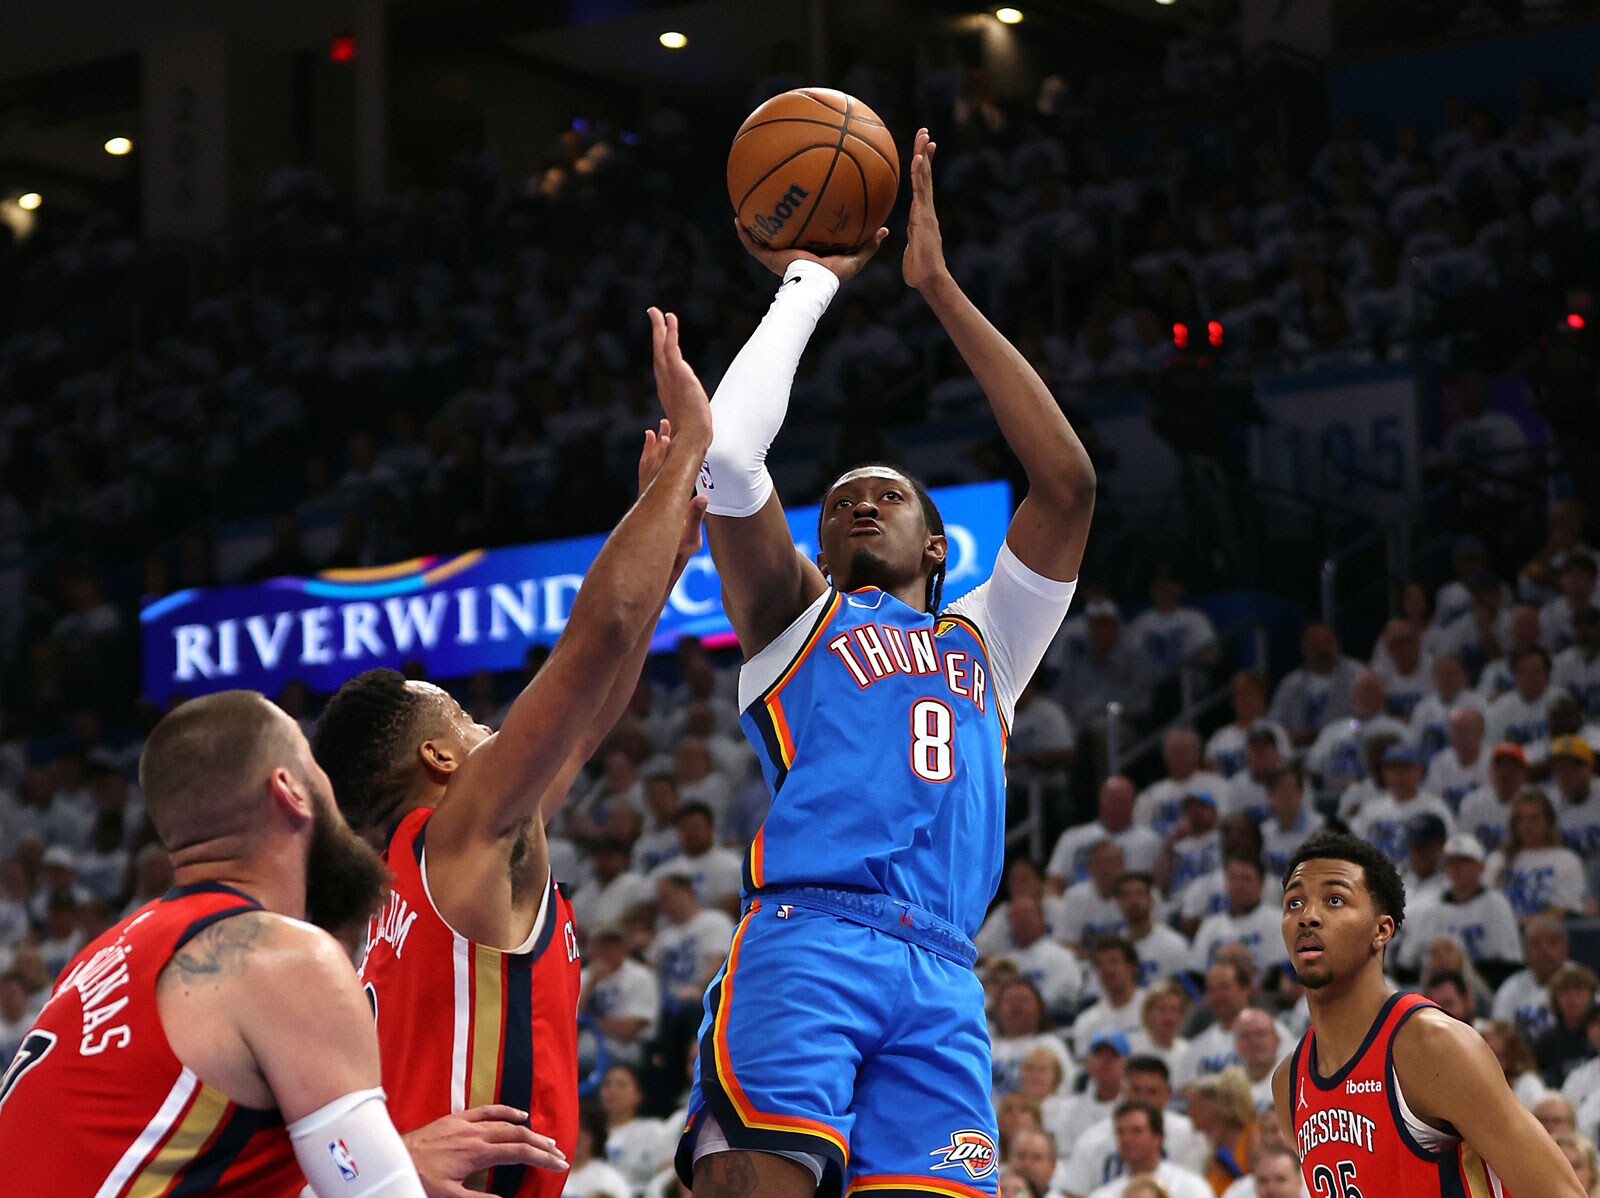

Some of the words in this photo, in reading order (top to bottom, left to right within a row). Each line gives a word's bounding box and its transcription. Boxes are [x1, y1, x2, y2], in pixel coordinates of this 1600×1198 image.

[749, 183, 809, 242] ilson
[827, 622, 986, 716] THUNER
[910, 697, 955, 784] 8
[1346, 1079, 1382, 1095] ibotta
[947, 1142, 993, 1161] OKC
[1298, 1108, 1376, 1165] CRESCENT
